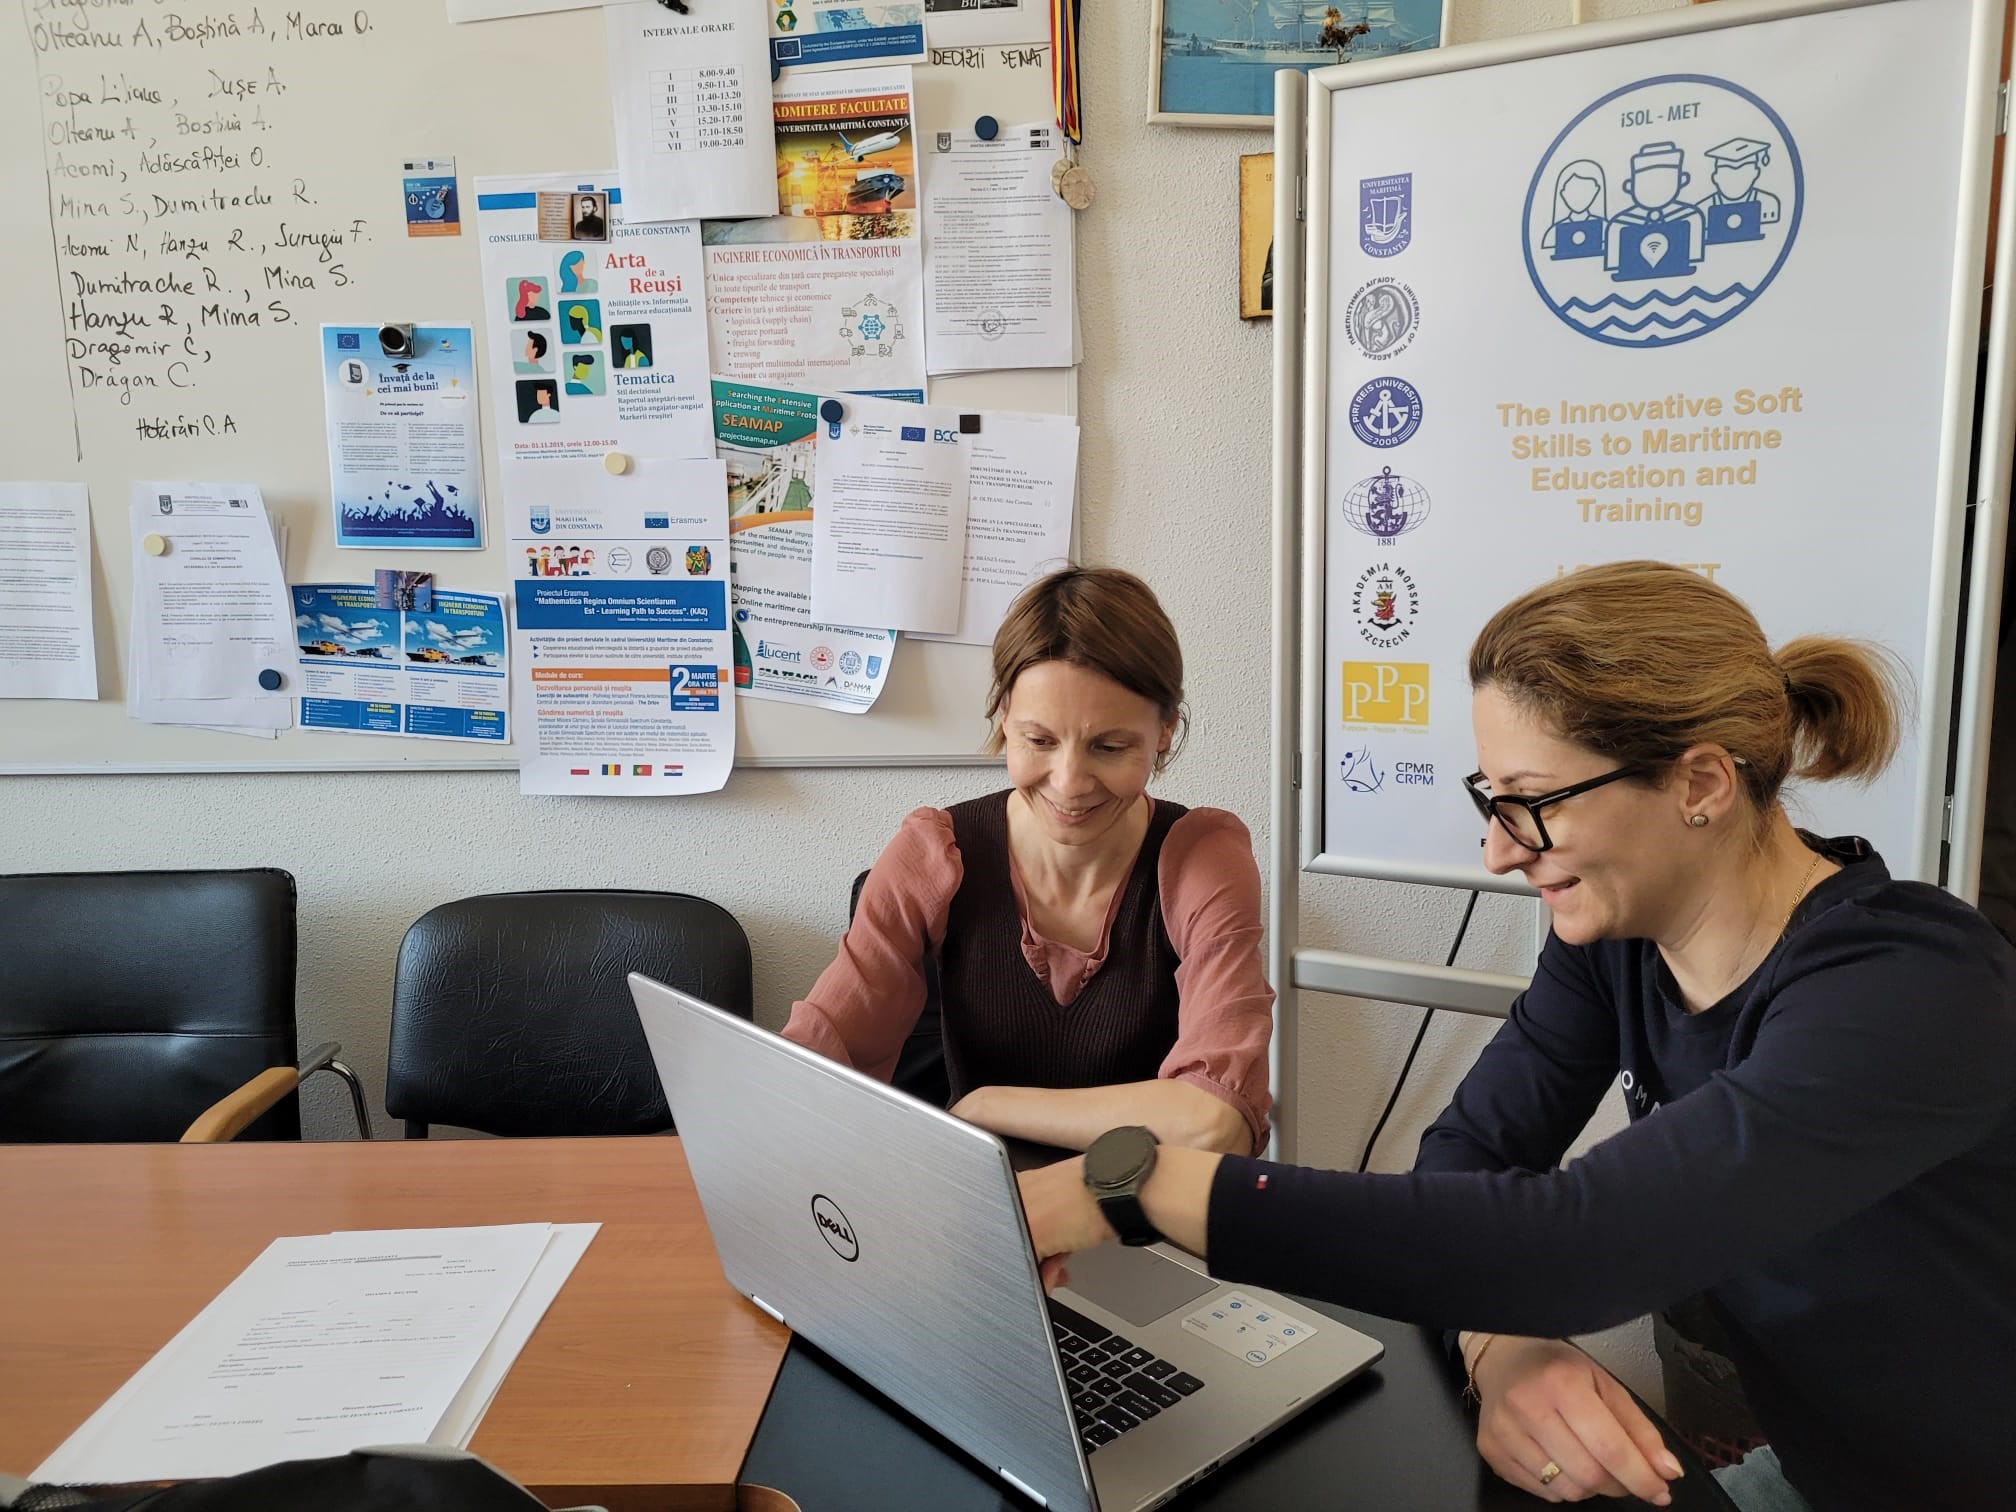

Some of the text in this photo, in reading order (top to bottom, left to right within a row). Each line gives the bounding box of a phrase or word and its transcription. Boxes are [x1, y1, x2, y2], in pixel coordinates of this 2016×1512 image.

[643, 22, 735, 38] INTERVALE ORARE
[1001, 46, 1050, 69] SENAT
[699, 68, 735, 78] 8.00-9.40
[697, 79, 738, 90] 9.50-11.30
[696, 91, 741, 102] 11.40-13.20
[667, 103, 742, 116] IV 13.30-15.10
[774, 97, 908, 118] ADMITERE FACULTATE
[1620, 102, 1701, 128] iSOL MET
[670, 115, 743, 128] V 15.20-17.00
[669, 126, 743, 139] VI 17.10-18.50
[668, 138, 744, 151] VII 19.00-20.40
[1362, 177, 1410, 189] UNIVERSITATEA
[605, 252, 646, 269] Arta
[713, 251, 761, 264] INGINERIE
[832, 245, 901, 259] TRANSPORTURI
[645, 268, 657, 277] de
[71, 270, 196, 298] Dumitrache
[264, 265, 316, 290] Mina
[629, 275, 682, 296] Reuși
[1403, 283, 1420, 331] UNIVERSITY
[66, 338, 172, 365] Dragomir
[412, 372, 424, 381] de
[426, 371, 435, 380] la
[613, 372, 675, 386] Tematica
[377, 381, 439, 394] cei mai buni!
[1357, 384, 1375, 402] REIS
[728, 389, 812, 409] Searching the Extensive
[1496, 386, 1803, 427] The Innovative Soft
[753, 404, 760, 412] at
[762, 405, 795, 417] Maritime
[722, 413, 784, 433] SEAMAP
[719, 431, 778, 446] projectseamap.eu
[933, 428, 959, 443] BCC
[1511, 426, 1782, 460] Skills to Maritime
[1531, 459, 1757, 491] Education and
[1577, 498, 1703, 526] Training
[768, 526, 793, 535] SEAMAP
[1377, 537, 1396, 547] 1881
[563, 589, 589, 597] Erasmus
[731, 583, 807, 600] Mapping the available
[1352, 562, 1419, 616] AKADEMIA MORSKA
[583, 597, 677, 606] Regina Omnium Scientiarum
[739, 597, 796, 613] Online maritime
[601, 608, 630, 616] Learning
[690, 608, 708, 616] (KA2)
[750, 614, 886, 641] The entrepreneurship maritime sector
[1360, 627, 1410, 649] SZCZECIN
[672, 667, 717, 697] 2 MARTIE
[1395, 761, 1434, 774] CPMR
[1395, 773, 1434, 786] CRPM
[817, 1211, 853, 1245] DELL
